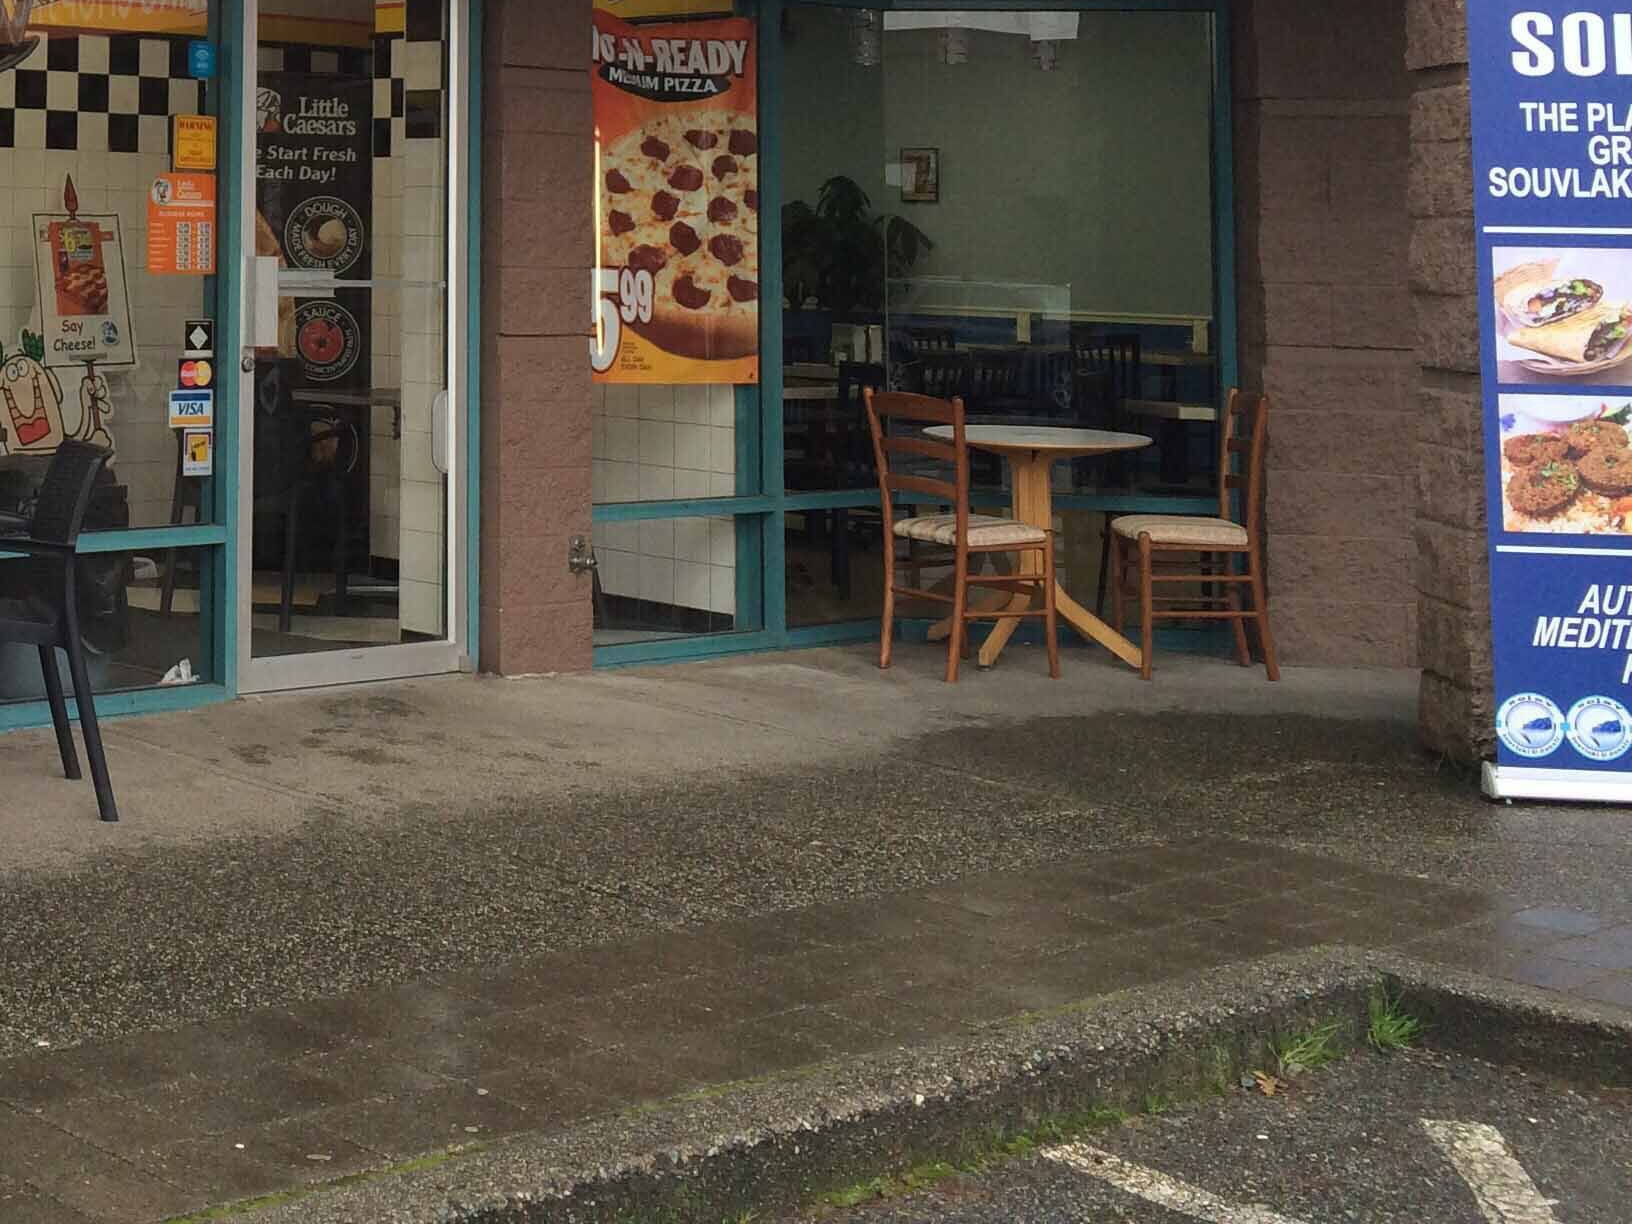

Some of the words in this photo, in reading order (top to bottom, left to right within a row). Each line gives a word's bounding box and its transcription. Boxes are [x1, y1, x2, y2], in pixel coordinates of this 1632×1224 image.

[663, 76, 718, 93] PIZZA
[298, 96, 350, 117] Little
[282, 113, 357, 136] Caesars
[1519, 102, 1579, 133] THE
[266, 144, 308, 161] Start
[312, 146, 357, 162] Fresh
[1588, 135, 1632, 166] GR
[256, 164, 294, 180] Each
[298, 165, 337, 184] Day!
[1488, 167, 1632, 199] SOUVLAK
[303, 202, 349, 220] DOUGH
[302, 307, 342, 326] SAUCE
[61, 319, 84, 336] Say
[52, 335, 97, 352] Cheese!
[177, 402, 204, 416] VISA
